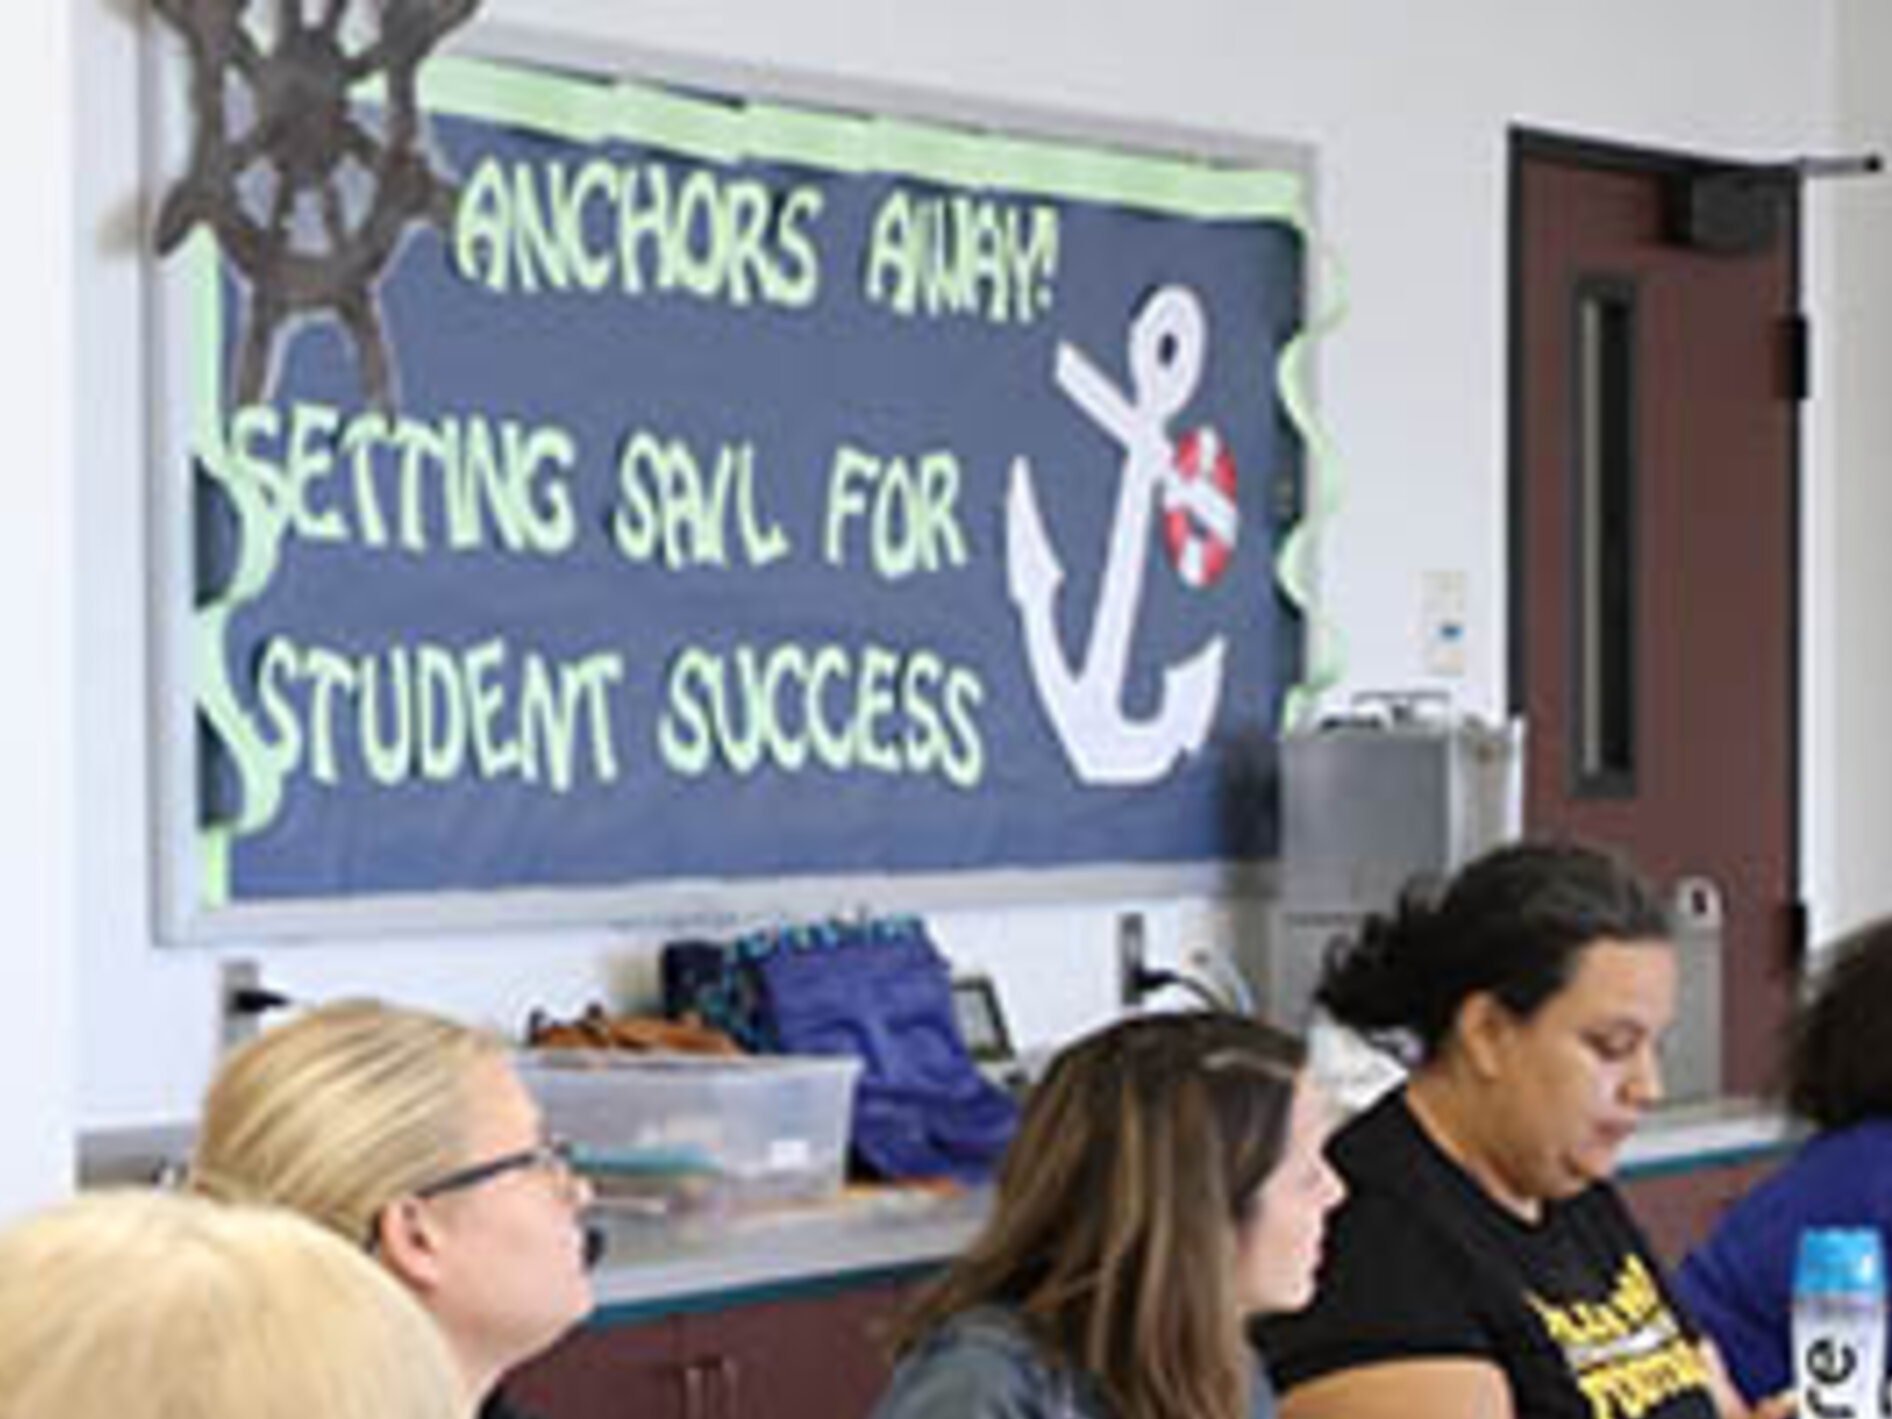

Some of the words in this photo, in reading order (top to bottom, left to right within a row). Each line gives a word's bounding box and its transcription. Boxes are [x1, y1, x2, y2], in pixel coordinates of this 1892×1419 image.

[455, 157, 822, 305] ANCHORS
[867, 192, 1060, 321] AWAY!
[232, 400, 575, 554] SETTING
[614, 430, 790, 571] SAIL
[825, 442, 967, 580] FOR
[255, 637, 622, 792] STUDENT
[658, 643, 984, 787] SUCCESS
